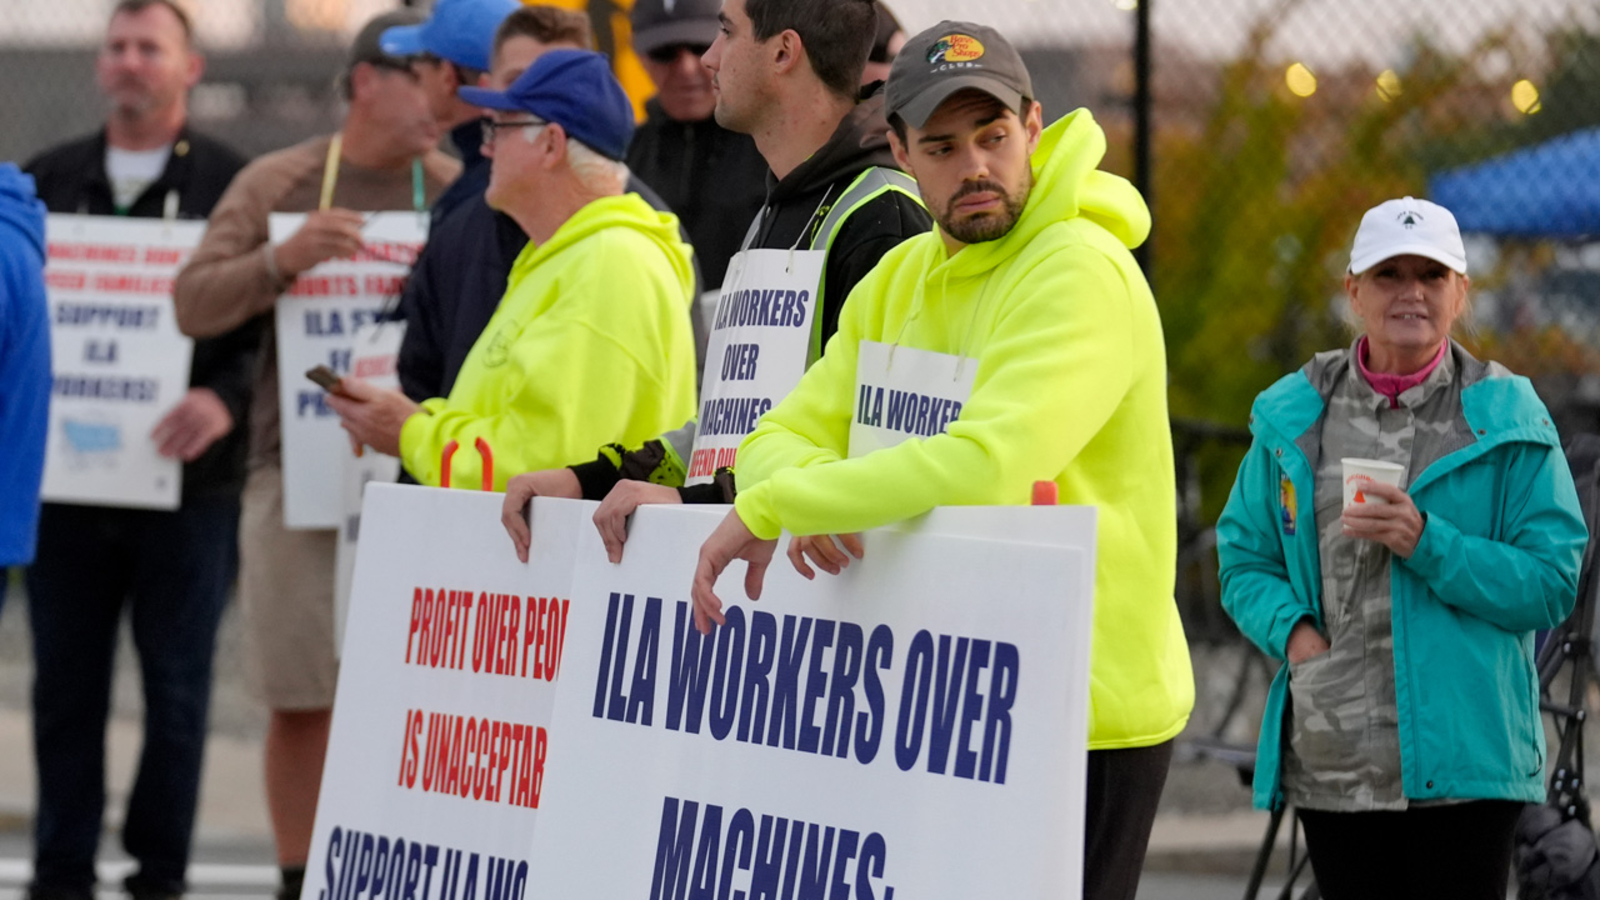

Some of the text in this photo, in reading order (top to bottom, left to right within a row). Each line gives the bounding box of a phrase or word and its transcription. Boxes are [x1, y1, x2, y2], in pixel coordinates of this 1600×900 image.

[939, 62, 973, 71] CLUB
[56, 303, 159, 329] SUPPORT
[304, 310, 345, 336] ILA
[728, 289, 810, 328] WORKERS
[84, 339, 118, 364] ILA
[721, 343, 760, 382] OVER
[857, 384, 884, 428] ILA
[405, 586, 474, 670] PROFIT
[472, 591, 521, 677] OVER
[592, 592, 1020, 785] ILA WORKERS OVER
[397, 708, 424, 790] IS
[318, 825, 441, 900] SUPPORT
